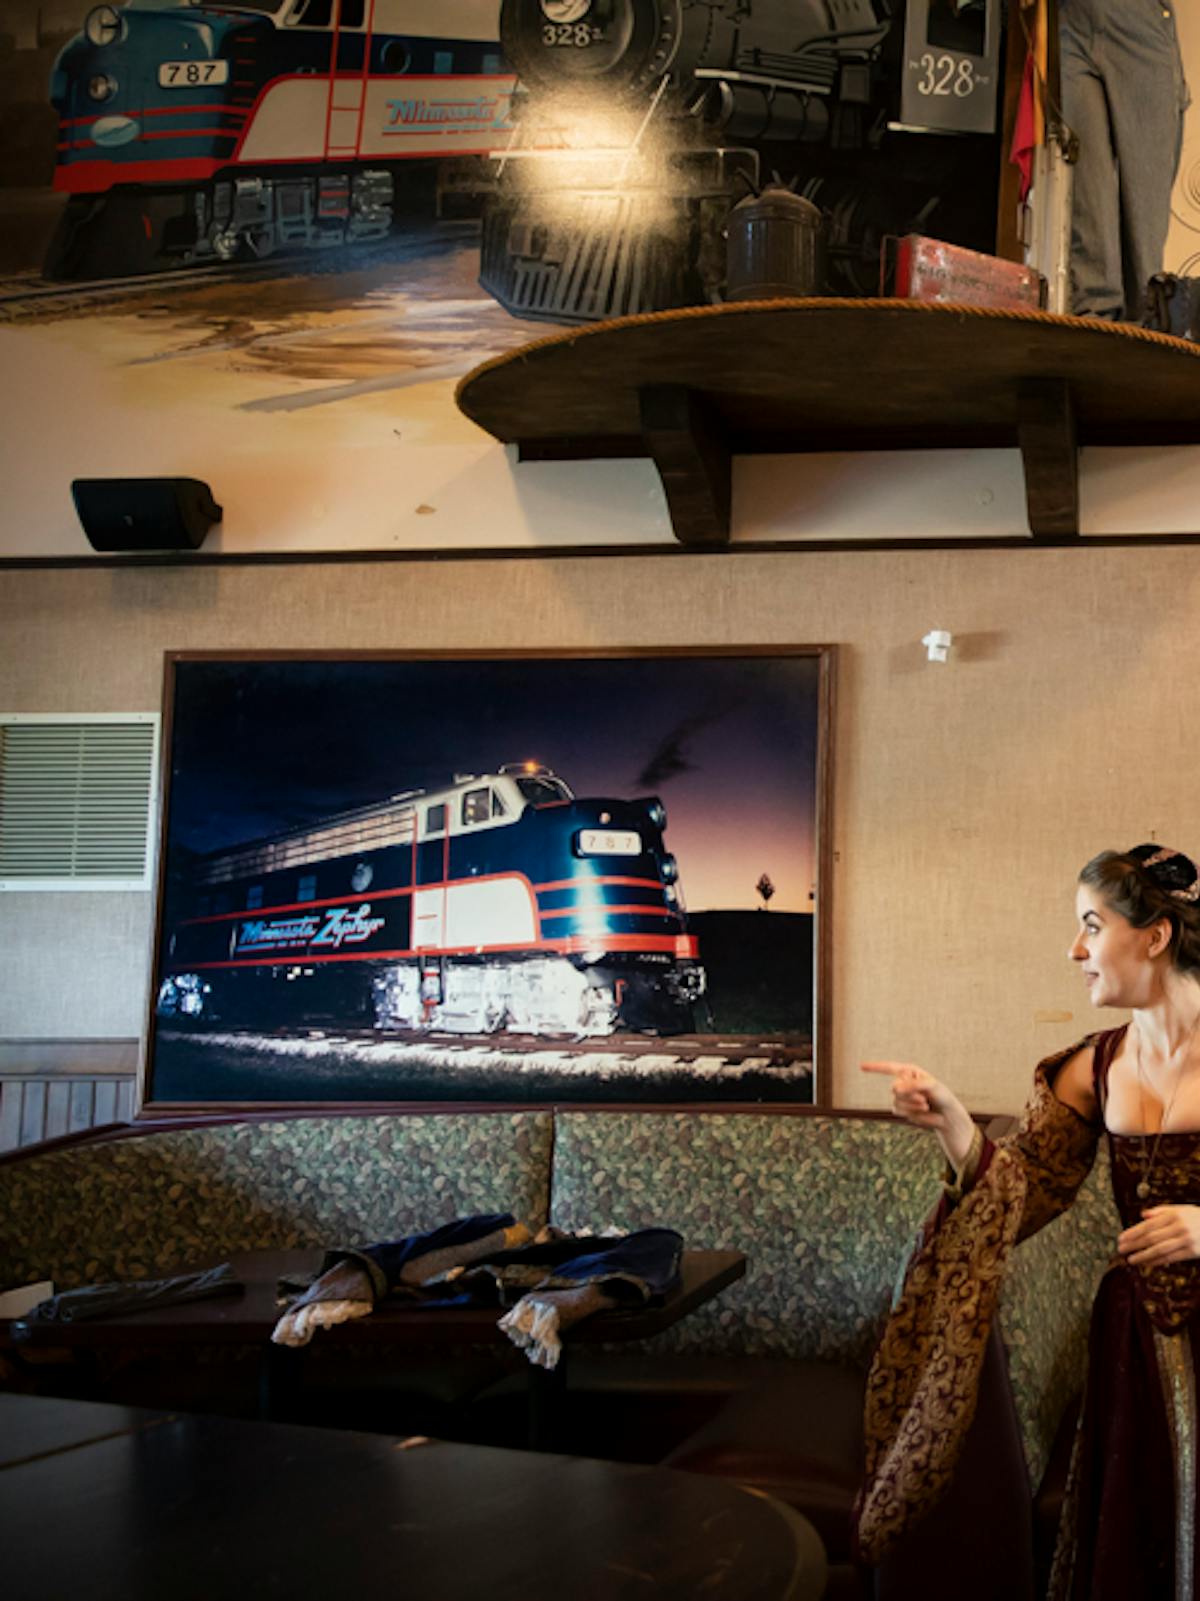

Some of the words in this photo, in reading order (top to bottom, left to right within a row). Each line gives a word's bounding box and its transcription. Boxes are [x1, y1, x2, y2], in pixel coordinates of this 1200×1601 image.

[543, 24, 591, 47] 328
[168, 64, 216, 83] 787
[918, 54, 974, 97] 328
[588, 836, 634, 849] 787
[310, 903, 385, 948] Zephyr
